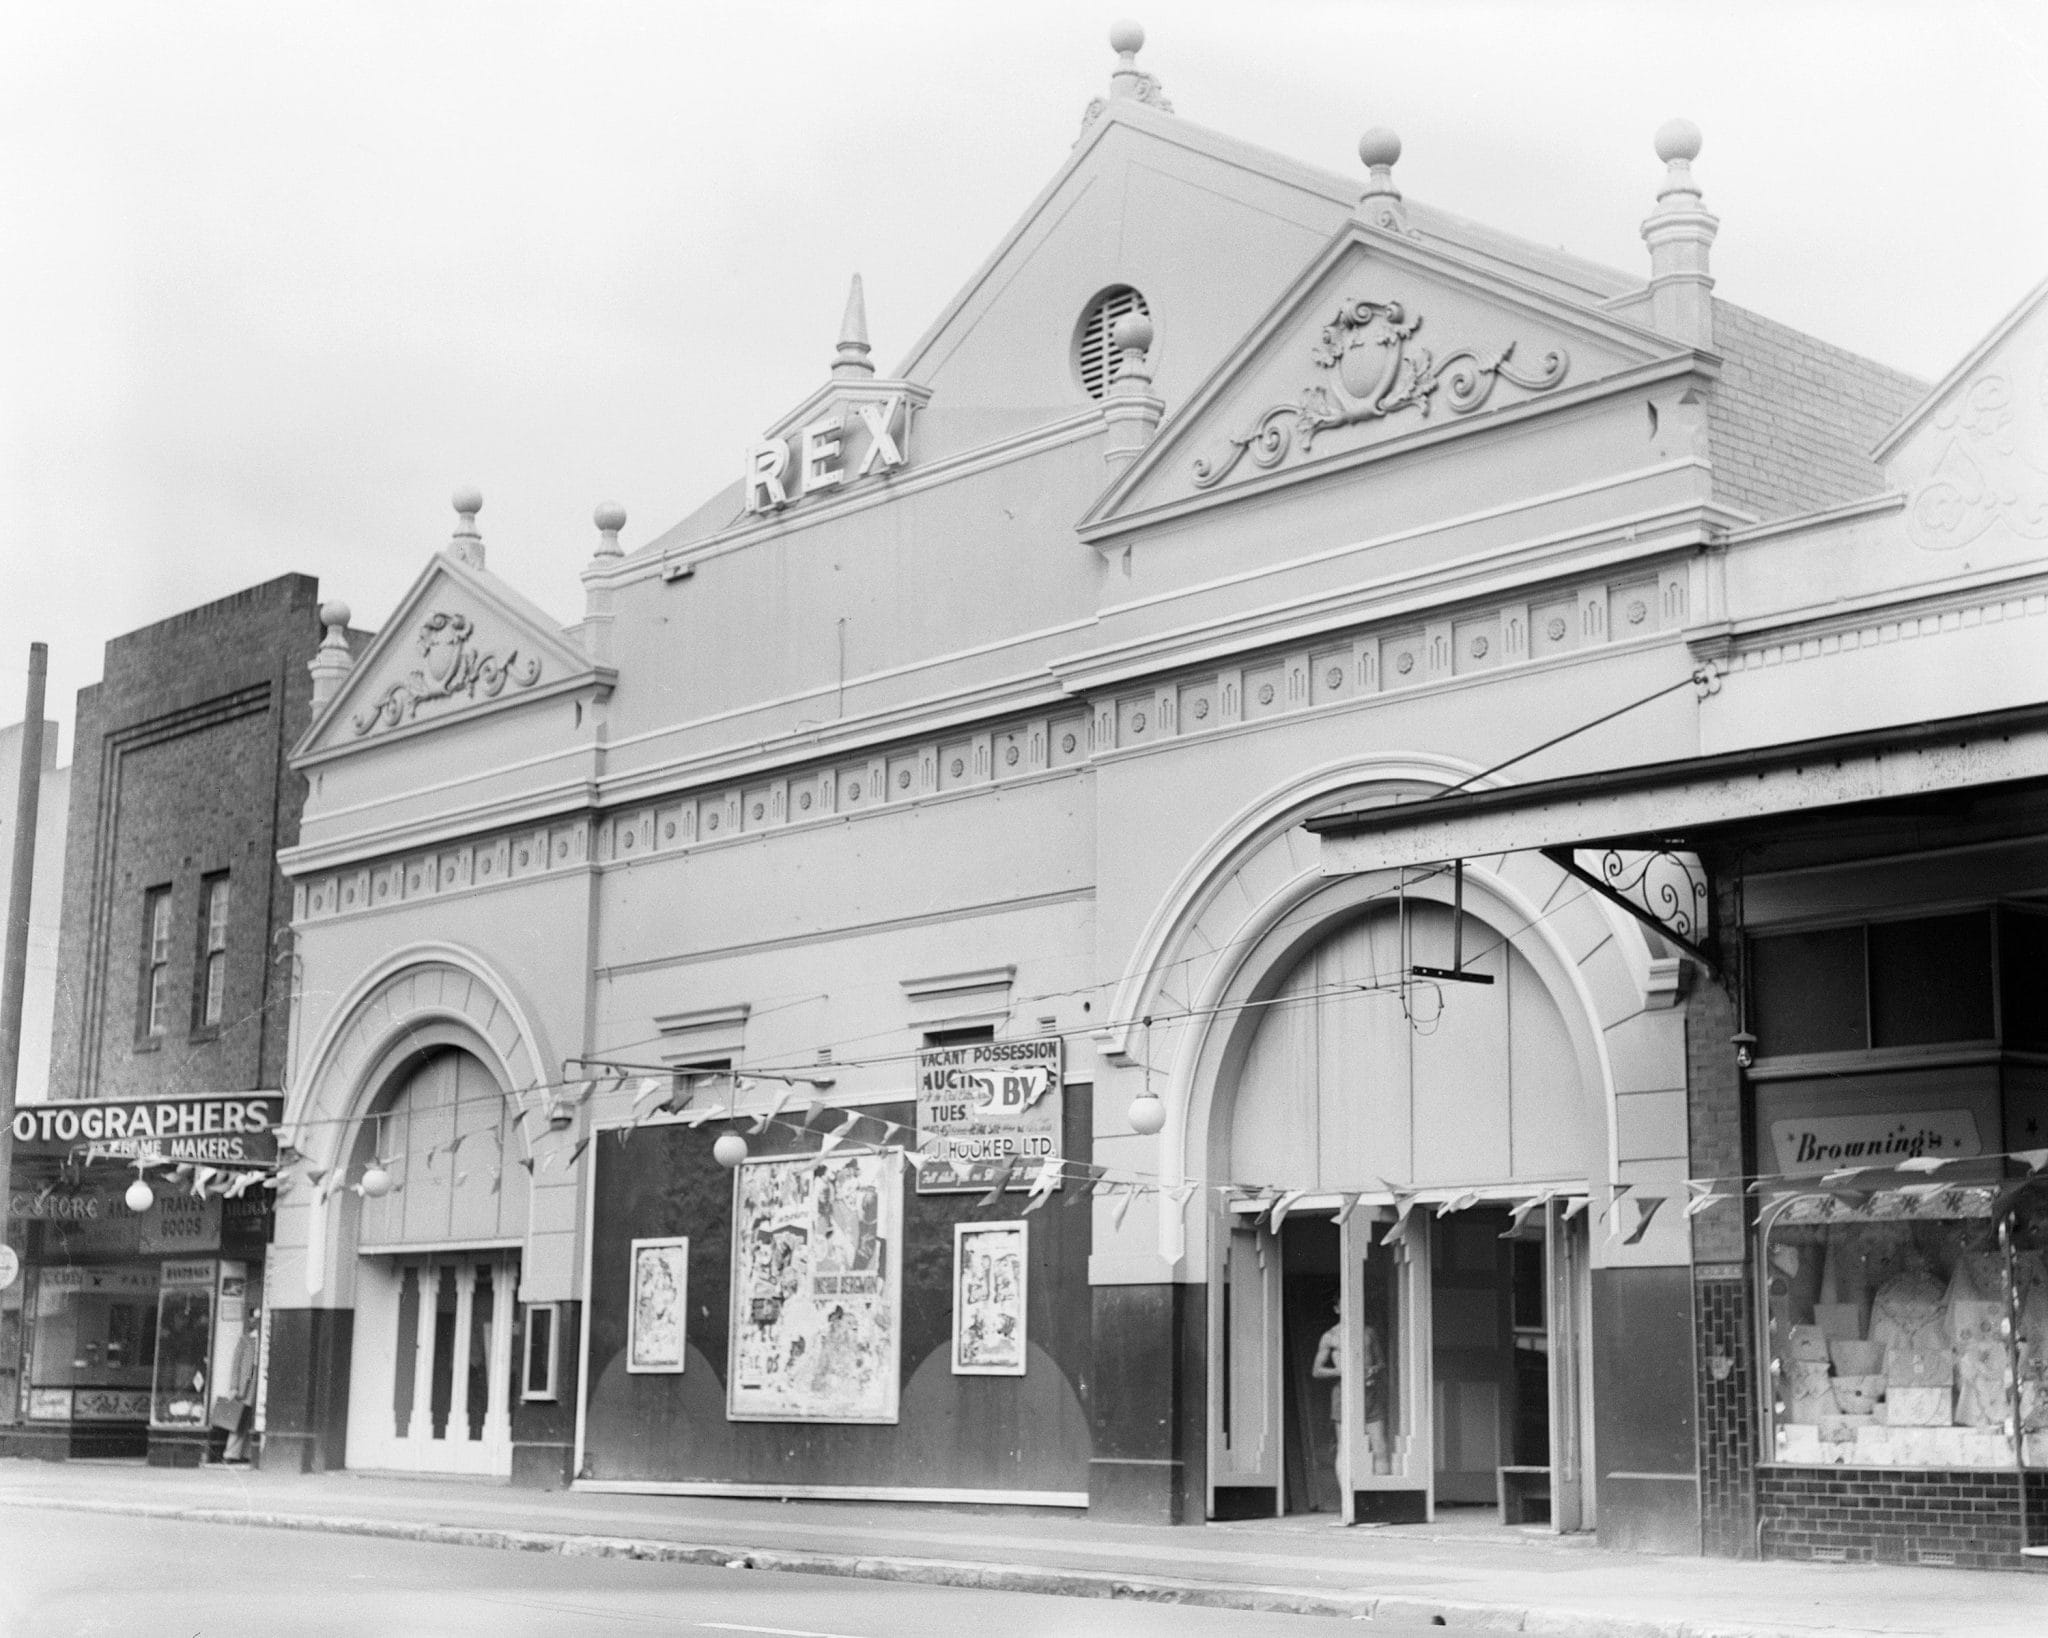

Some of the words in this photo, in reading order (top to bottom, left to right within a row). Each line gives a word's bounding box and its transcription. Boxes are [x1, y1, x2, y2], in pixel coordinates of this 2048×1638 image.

[745, 396, 908, 512] REX
[922, 1049, 965, 1067] VACANT
[974, 1042, 1056, 1063] POSSESSION
[1003, 1076, 1036, 1106] BY
[12, 1100, 269, 1141] OTOGRAPHERS
[948, 1138, 1014, 1159] HOOKER
[1023, 1137, 1055, 1156] LTD.
[1796, 1130, 1943, 1163] Browning's
